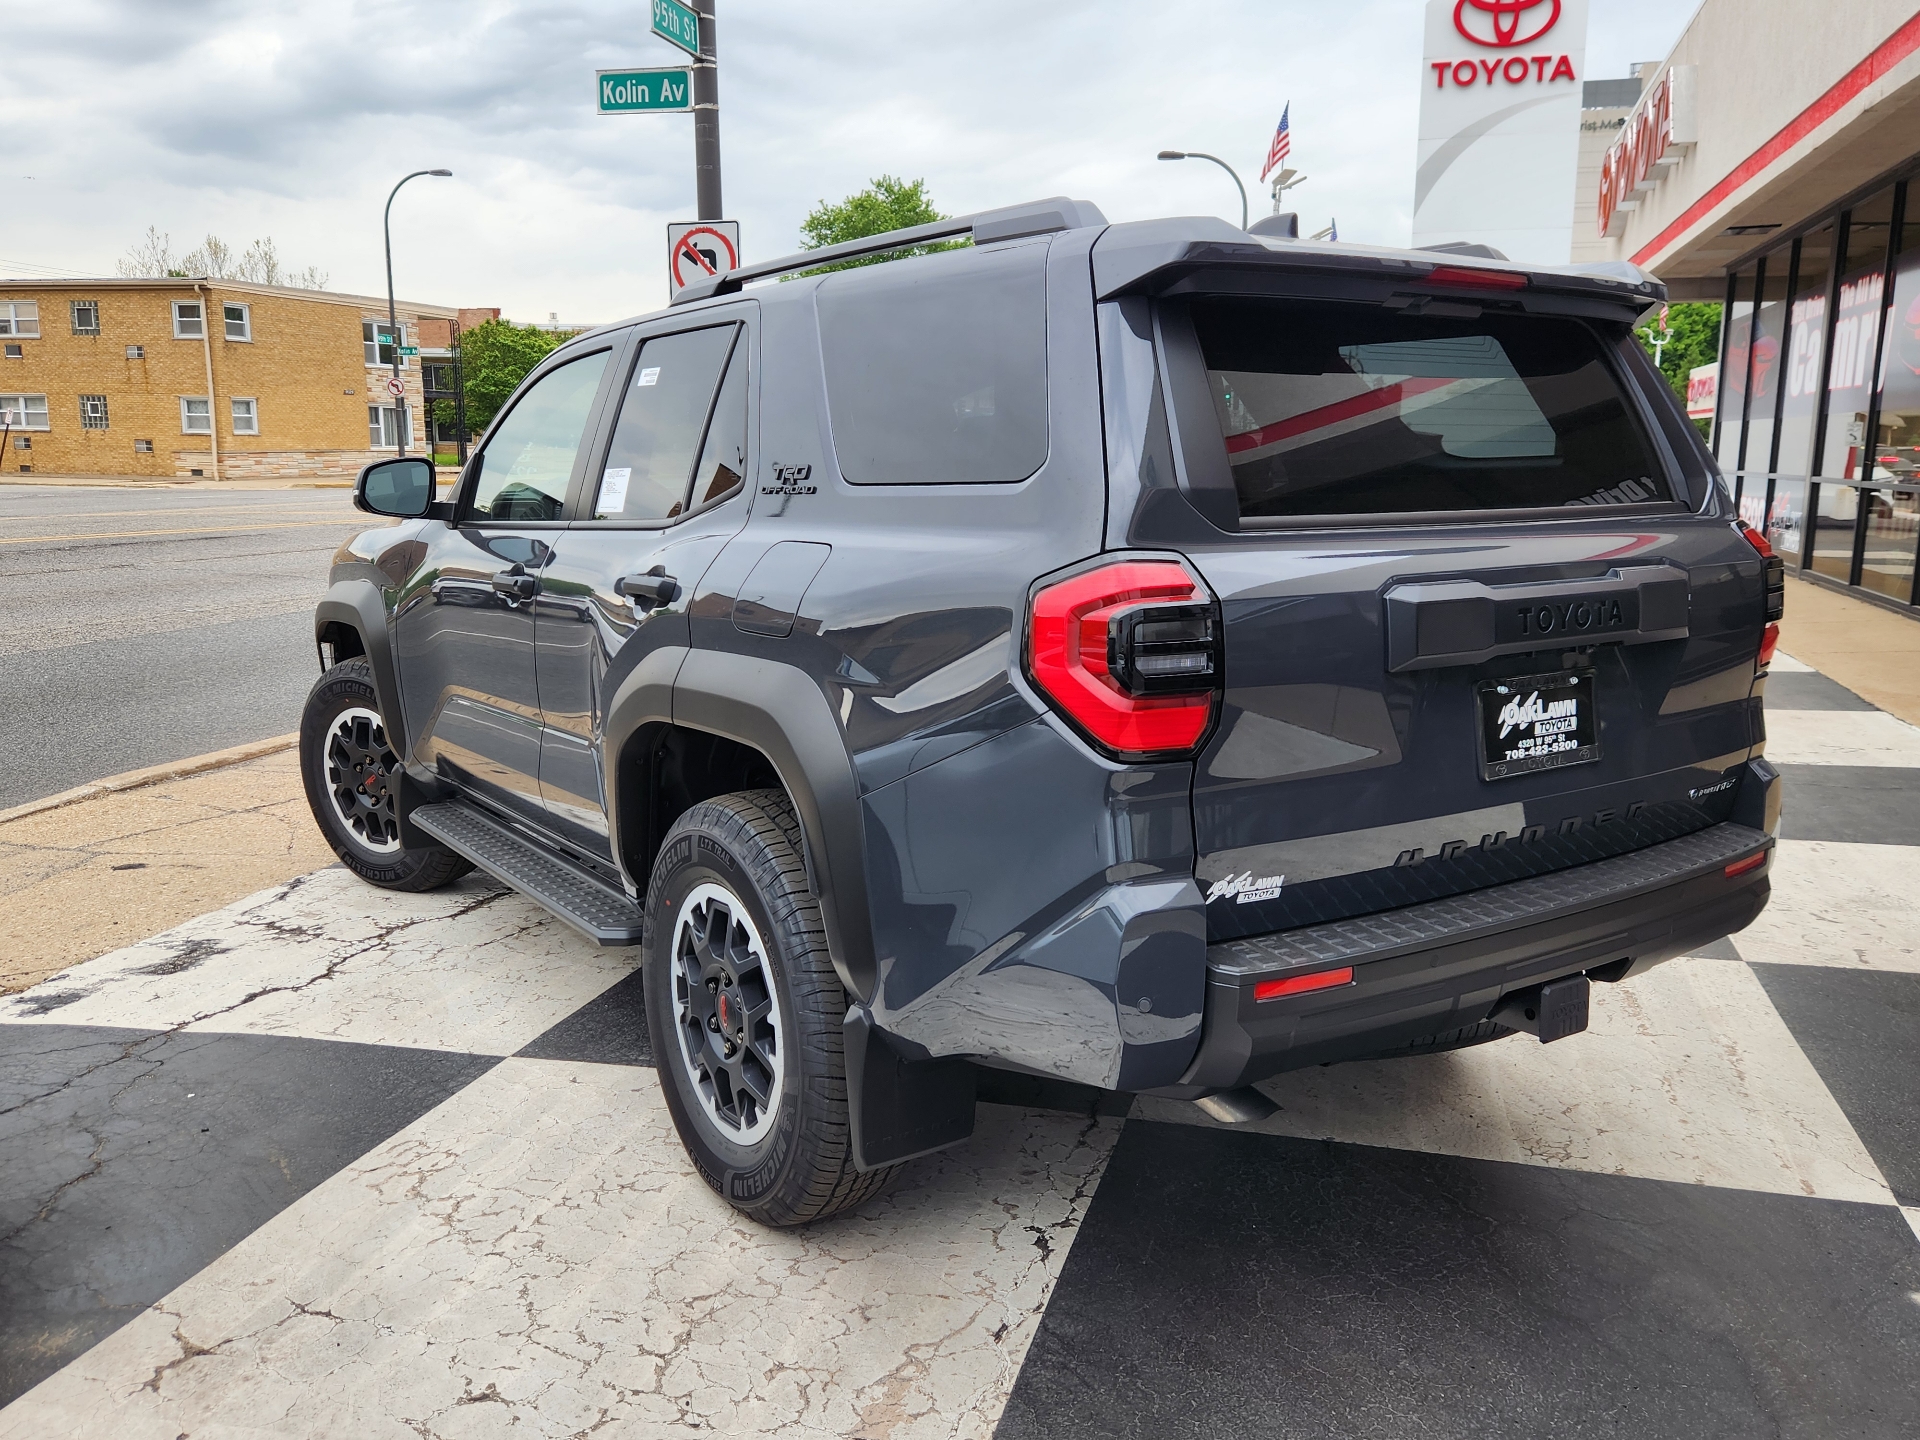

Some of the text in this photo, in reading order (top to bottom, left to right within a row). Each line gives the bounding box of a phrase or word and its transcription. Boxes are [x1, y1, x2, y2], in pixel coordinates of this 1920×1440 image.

[653, 0, 697, 46] 95th St
[1431, 55, 1576, 88] TOYOTA
[602, 78, 685, 105] Kolin Av
[1840, 282, 1856, 310] The
[1789, 305, 1896, 397] Camry
[772, 463, 812, 486] TRD
[1517, 599, 1625, 636] TOYOTA
[332, 682, 374, 699] MICHEL
[1540, 718, 1573, 733] TOYOTA
[1504, 740, 1578, 760] 708-423-5200
[1517, 738, 1535, 749] 4320
[1535, 737, 1543, 746] W
[1557, 733, 1565, 742] St
[344, 855, 396, 881] MICHELIN
[649, 836, 731, 915] MICHELIN LTX TRAIL
[1243, 889, 1274, 900] TOYOTA
[734, 1131, 787, 1198] MICHELIN
